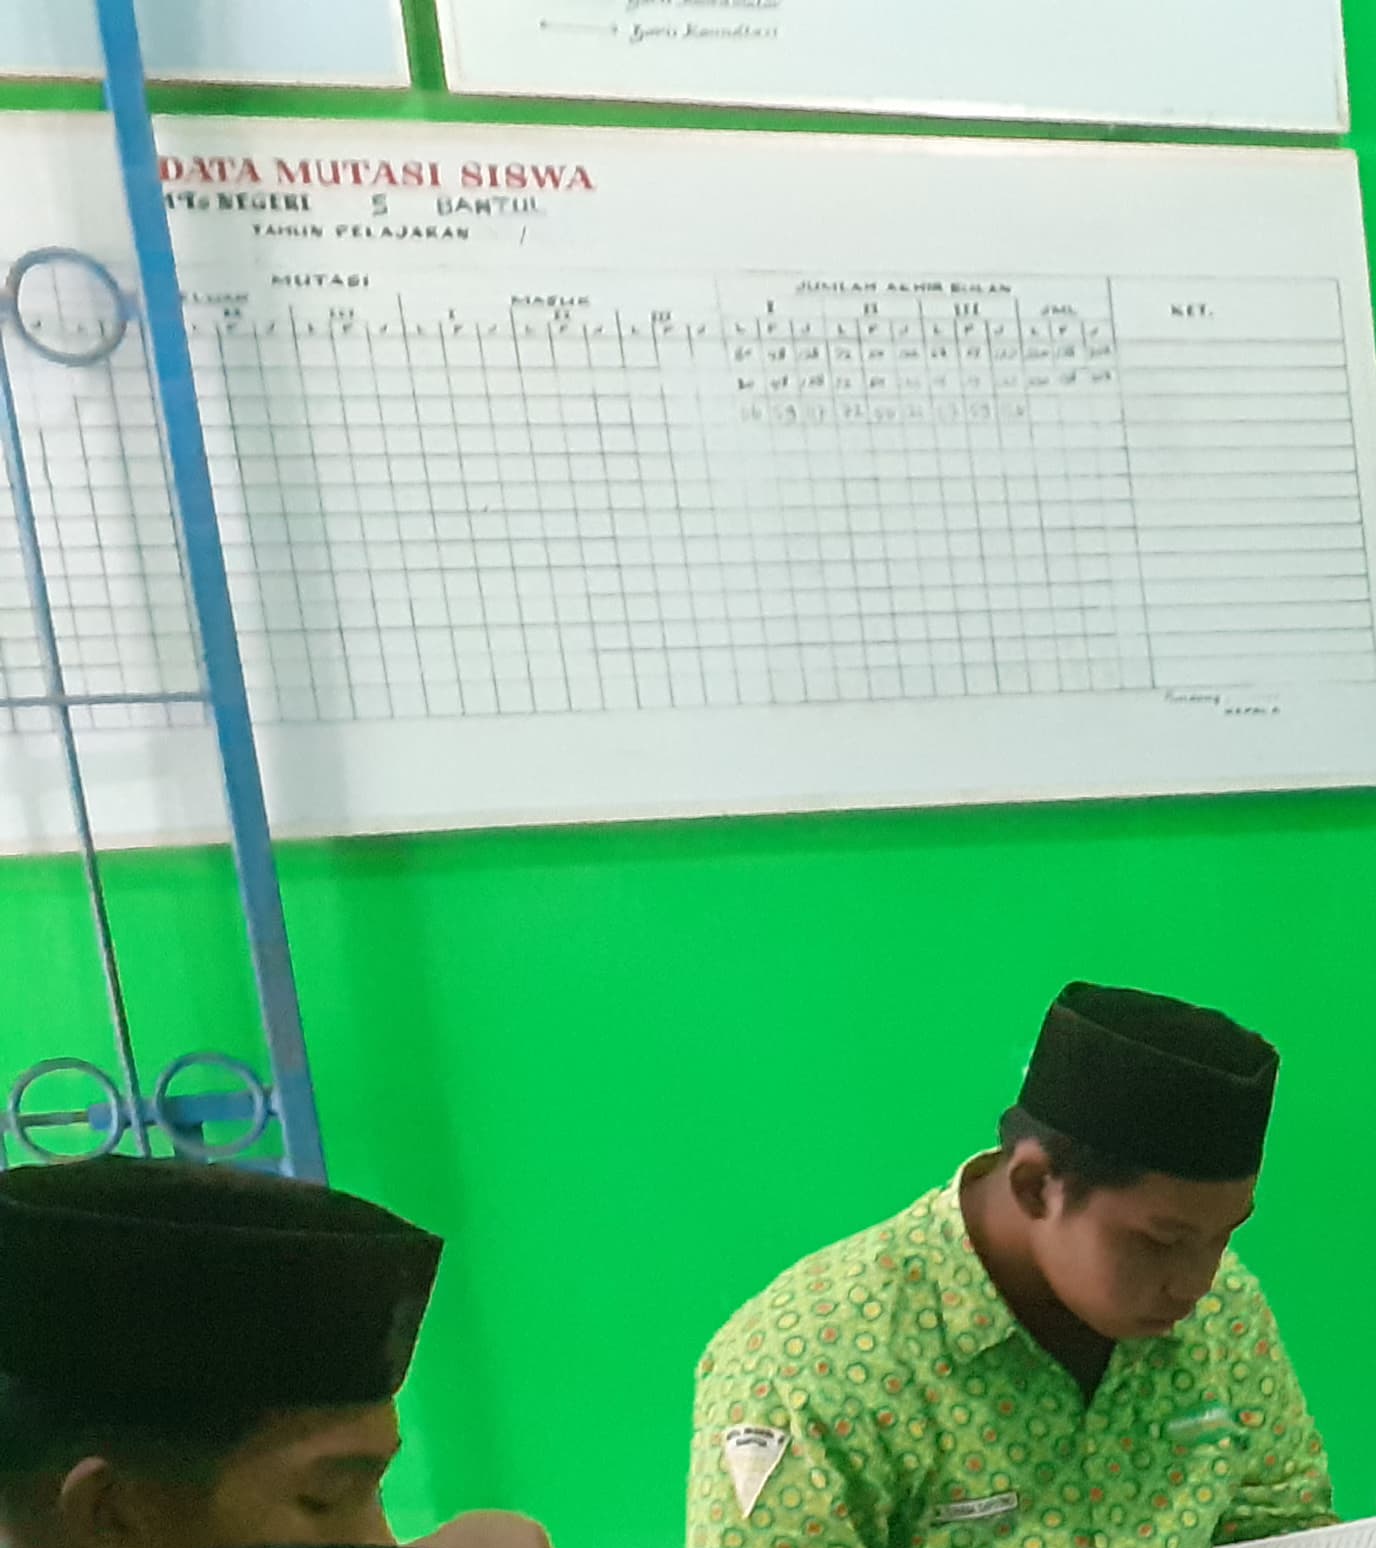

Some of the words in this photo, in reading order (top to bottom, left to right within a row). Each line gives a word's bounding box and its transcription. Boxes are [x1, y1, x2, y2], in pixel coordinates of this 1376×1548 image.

[159, 155, 262, 184] DATA
[273, 157, 442, 188] MUTASI
[461, 160, 597, 191] SISWA
[217, 190, 311, 214] NEGERI
[436, 195, 547, 218] BANTUL
[335, 223, 470, 241] PELAJARAN
[271, 273, 370, 289] MUTASI
